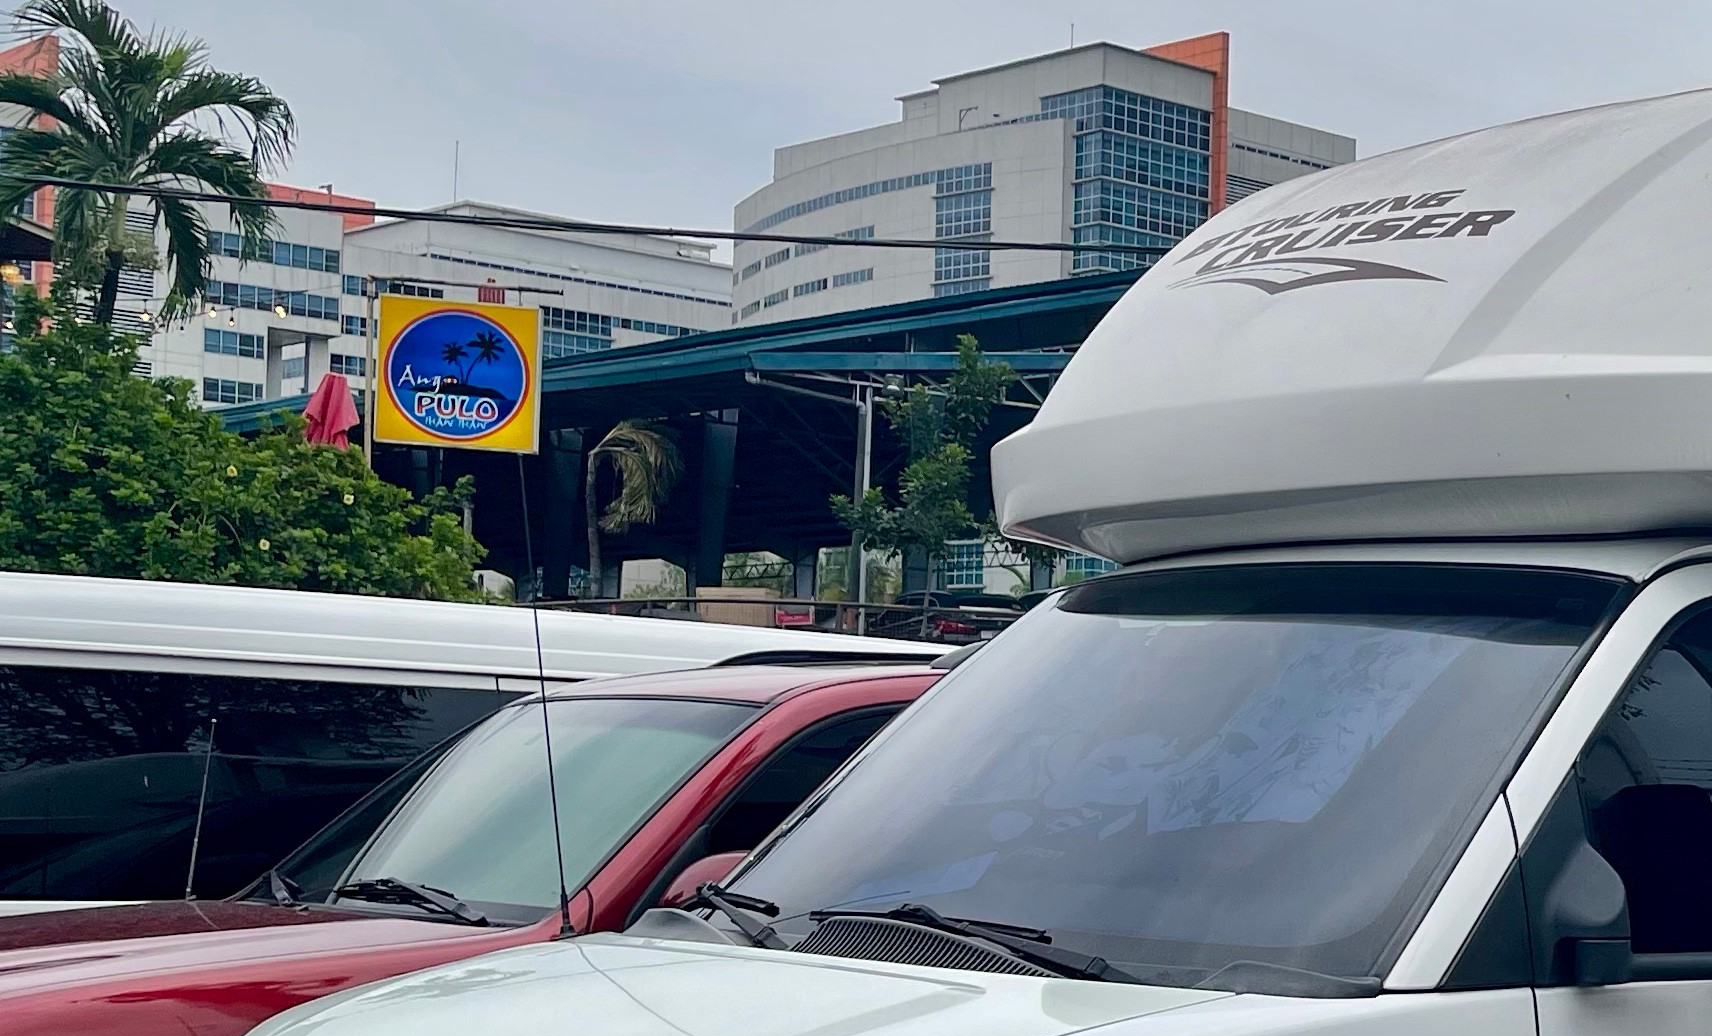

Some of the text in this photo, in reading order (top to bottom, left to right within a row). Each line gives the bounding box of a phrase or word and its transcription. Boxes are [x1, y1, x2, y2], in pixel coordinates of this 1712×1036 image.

[1219, 189, 1467, 248] TOURING
[1196, 209, 1516, 275] CRUISER
[398, 364, 442, 393] Ang
[414, 392, 498, 422] PULO
